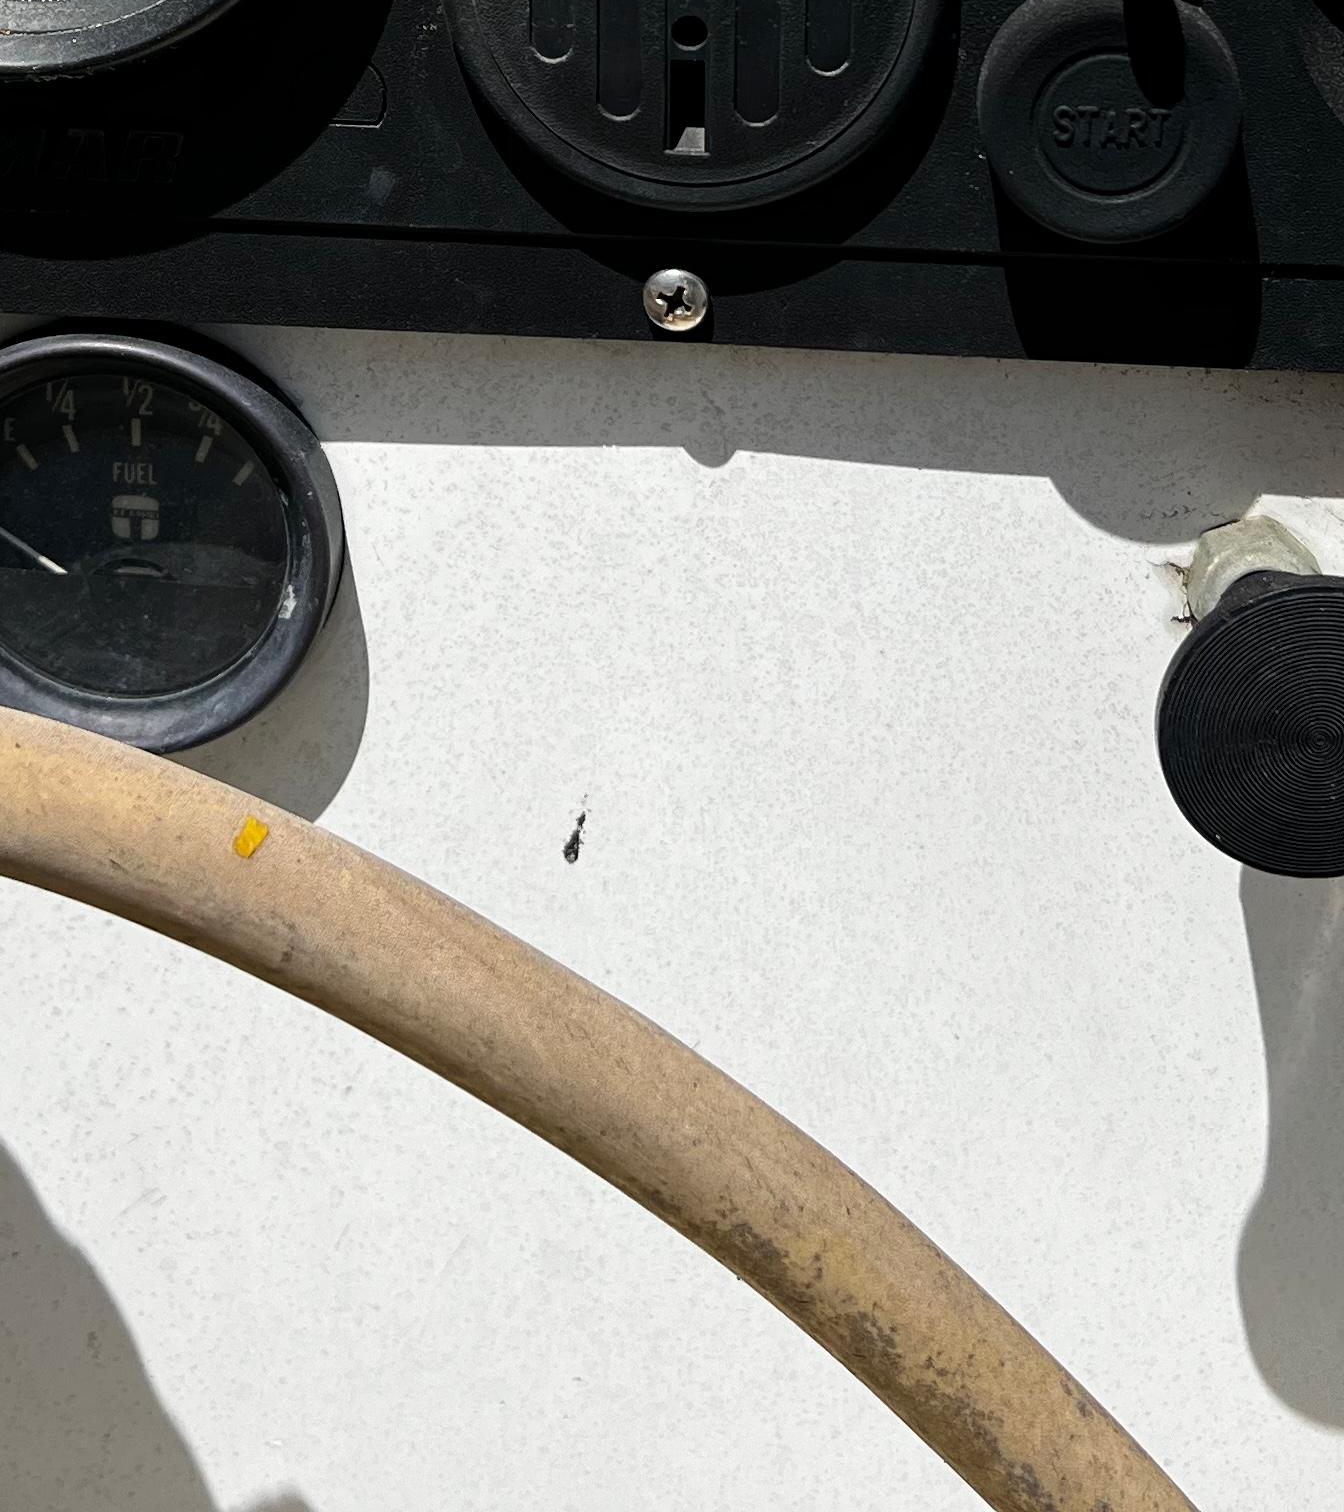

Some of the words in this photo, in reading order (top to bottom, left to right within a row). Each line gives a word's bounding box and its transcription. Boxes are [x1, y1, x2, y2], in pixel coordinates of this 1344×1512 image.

[1052, 104, 1174, 148] START
[3, 417, 15, 442] E
[112, 462, 157, 486] FUEL
